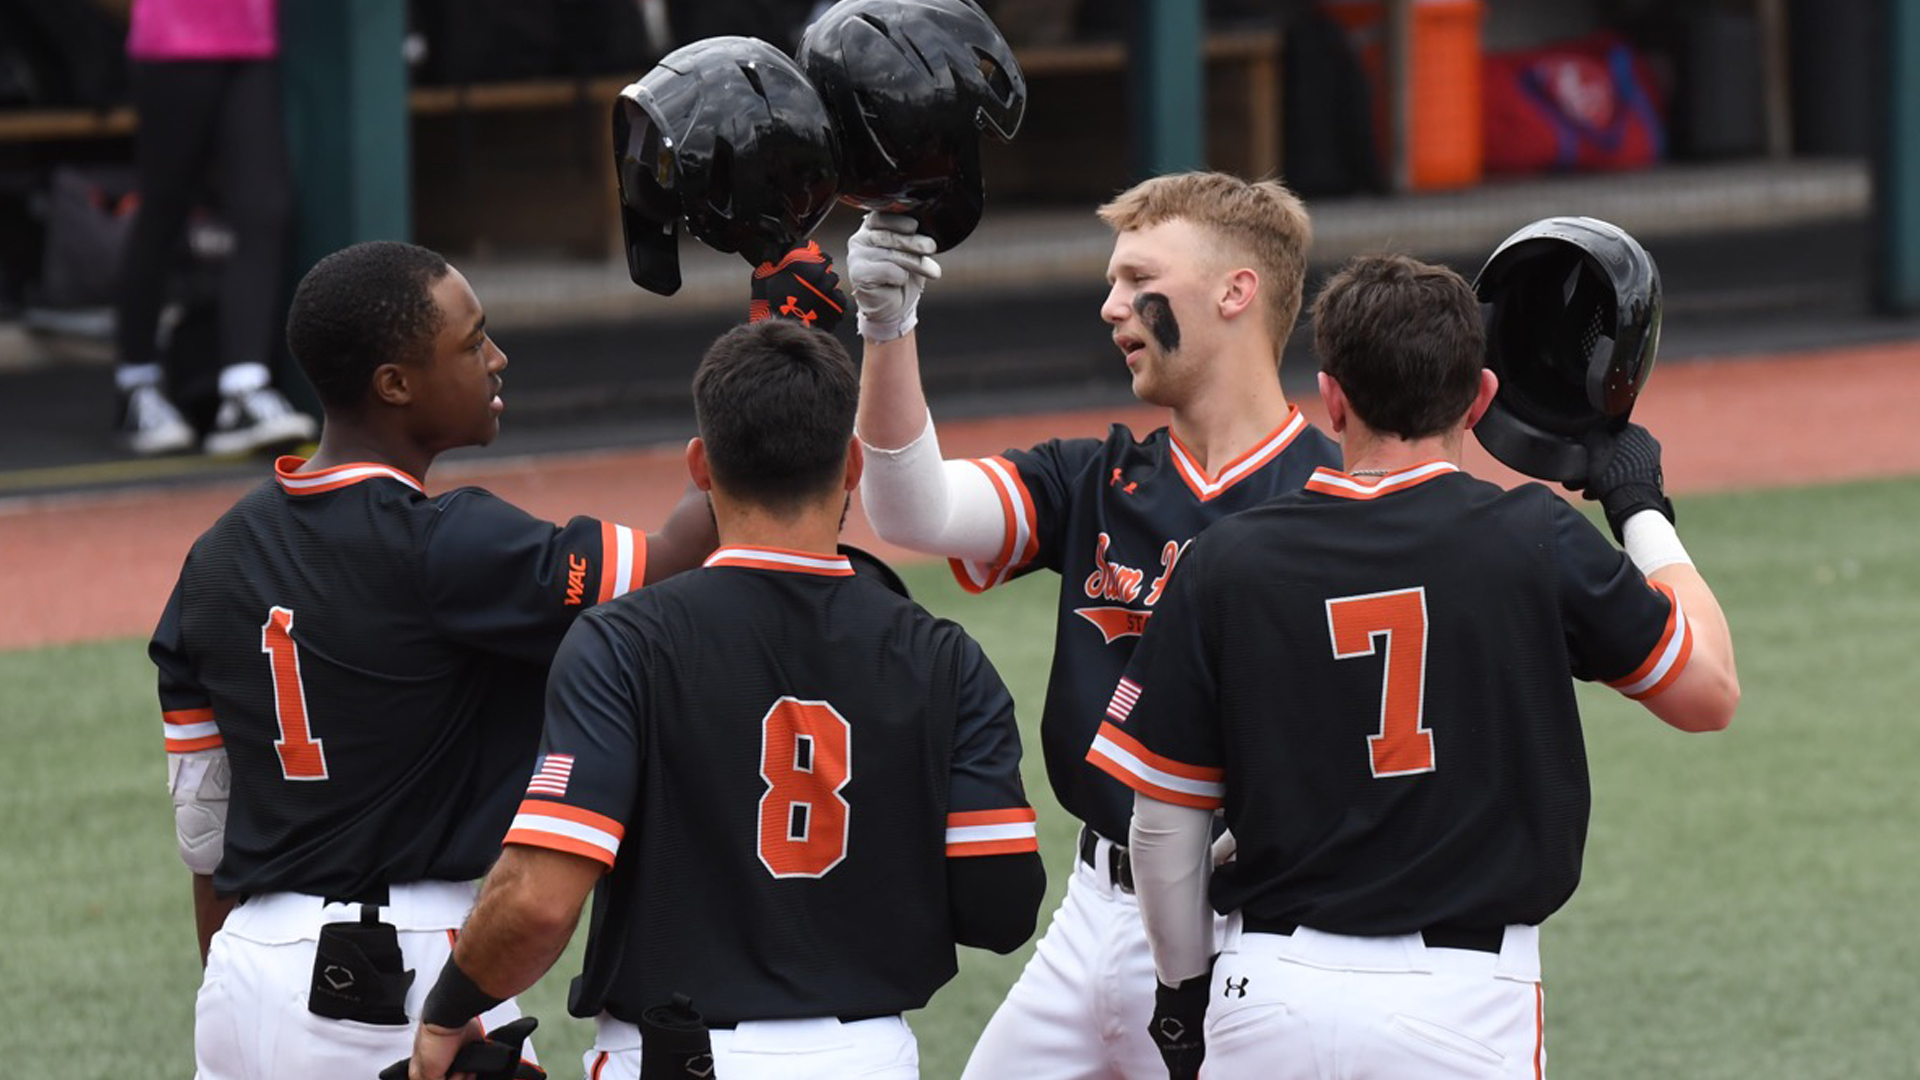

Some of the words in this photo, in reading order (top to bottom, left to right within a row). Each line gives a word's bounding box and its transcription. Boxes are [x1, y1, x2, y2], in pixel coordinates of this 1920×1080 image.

[564, 552, 587, 605] WAC
[1127, 614, 1149, 633] ST
[262, 605, 329, 781] 1
[1325, 586, 1436, 779] 7
[757, 696, 852, 879] 8
